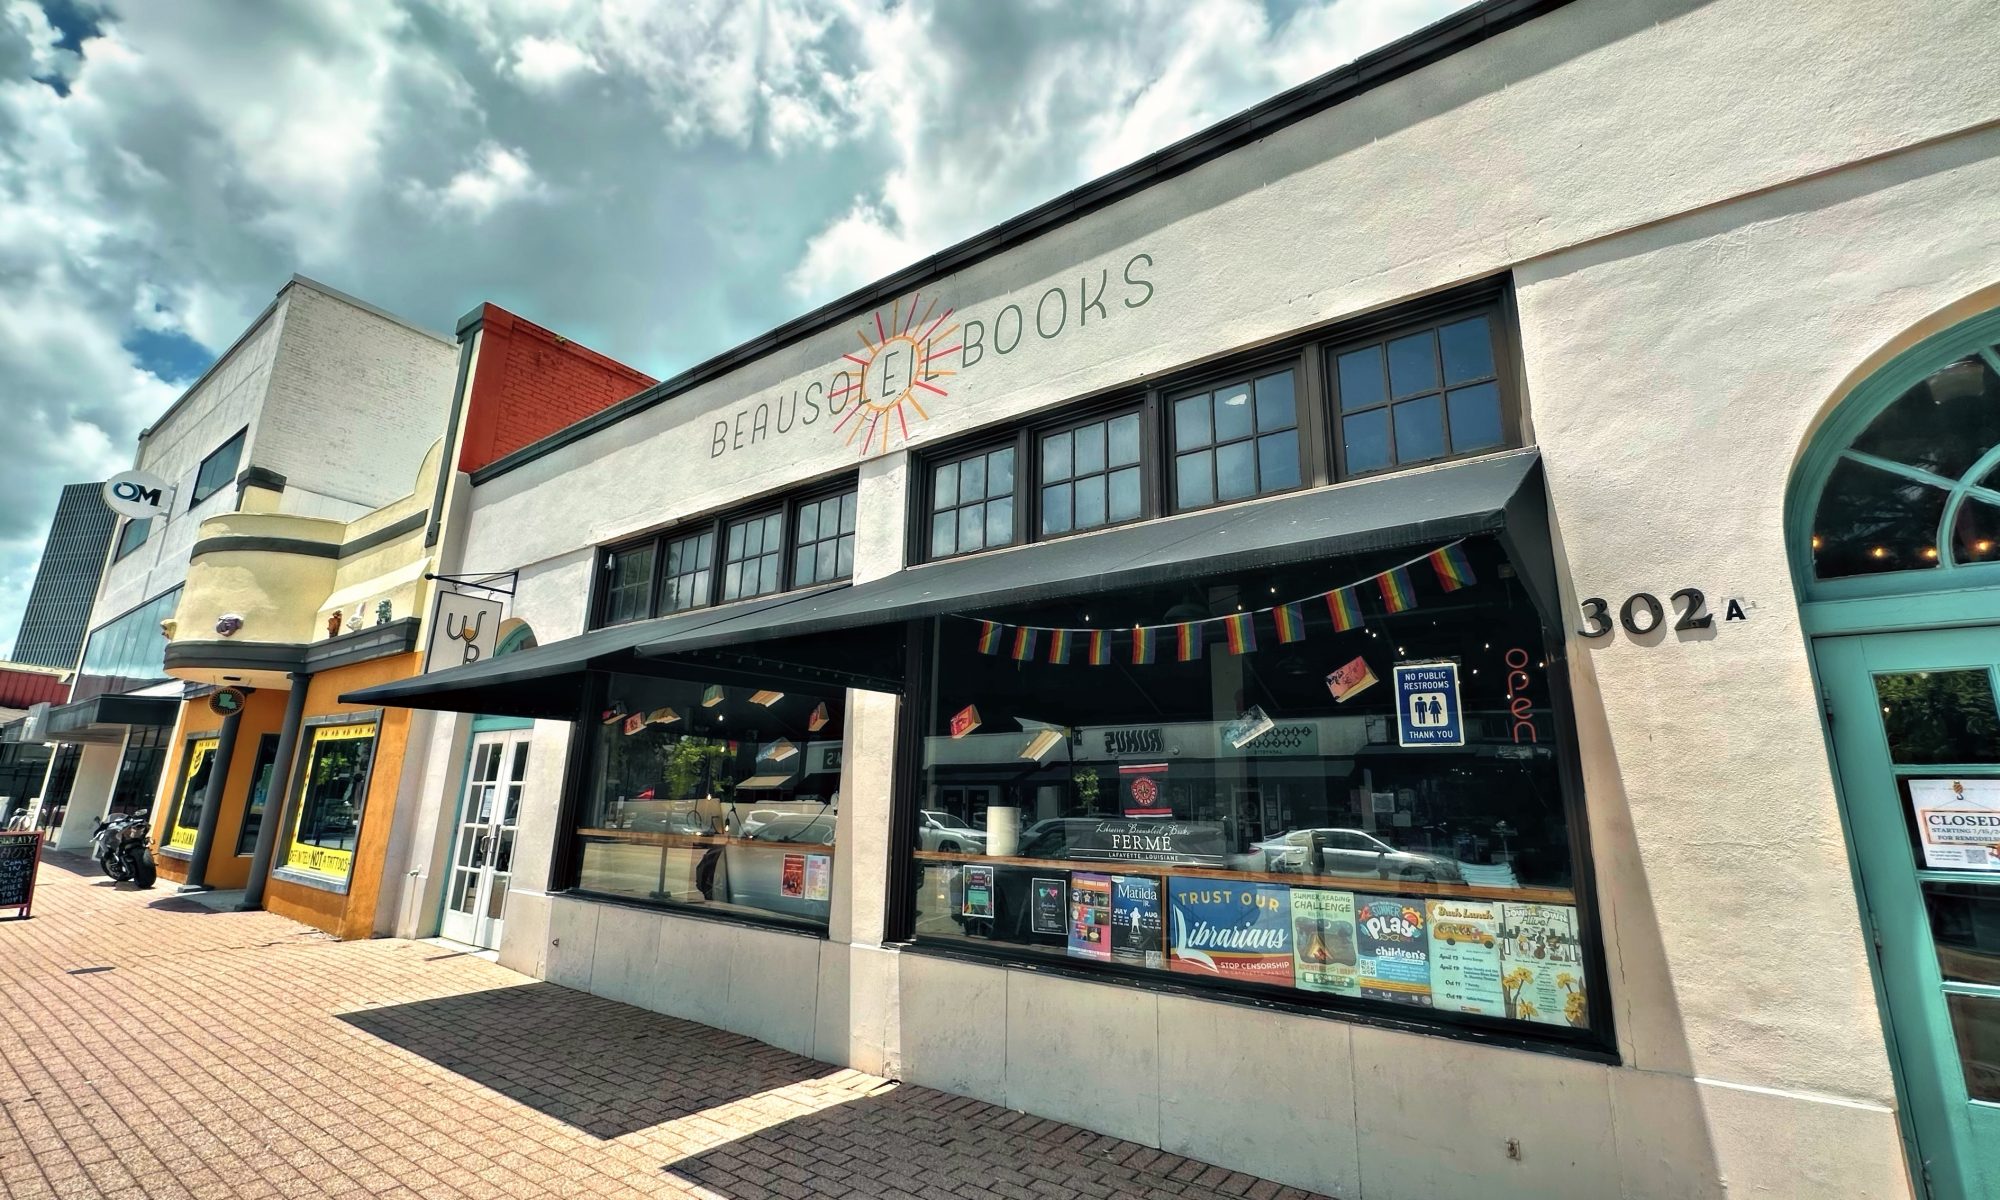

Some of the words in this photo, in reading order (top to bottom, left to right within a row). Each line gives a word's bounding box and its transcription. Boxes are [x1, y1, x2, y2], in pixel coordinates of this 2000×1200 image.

[711, 339, 940, 459] BEAUSOLEIL
[962, 253, 1155, 368] BOOKS
[113, 482, 161, 506] OM
[1577, 588, 1713, 638] 302
[1725, 599, 1746, 621] A
[1404, 673, 1416, 681] NO
[1418, 671, 1446, 680] PUBLIC
[1403, 680, 1449, 690] RESTROOMS
[1409, 730, 1435, 739] THANK
[1436, 730, 1453, 738] YOU
[1928, 815, 2000, 827] CLOSED
[1111, 833, 1172, 851] FERMÉ
[310, 850, 325, 867] NOT
[1118, 883, 1157, 901] Matilda
[1293, 892, 1320, 901] SUMMER
[1321, 894, 1351, 903] READING
[1178, 890, 1232, 905] TRUST
[1241, 892, 1280, 912] OUR
[1294, 900, 1351, 913] CHALLENGE
[1375, 946, 1426, 960] children's
[1220, 961, 1240, 969] STOP
[1241, 961, 1290, 970] CENSORSHIP
